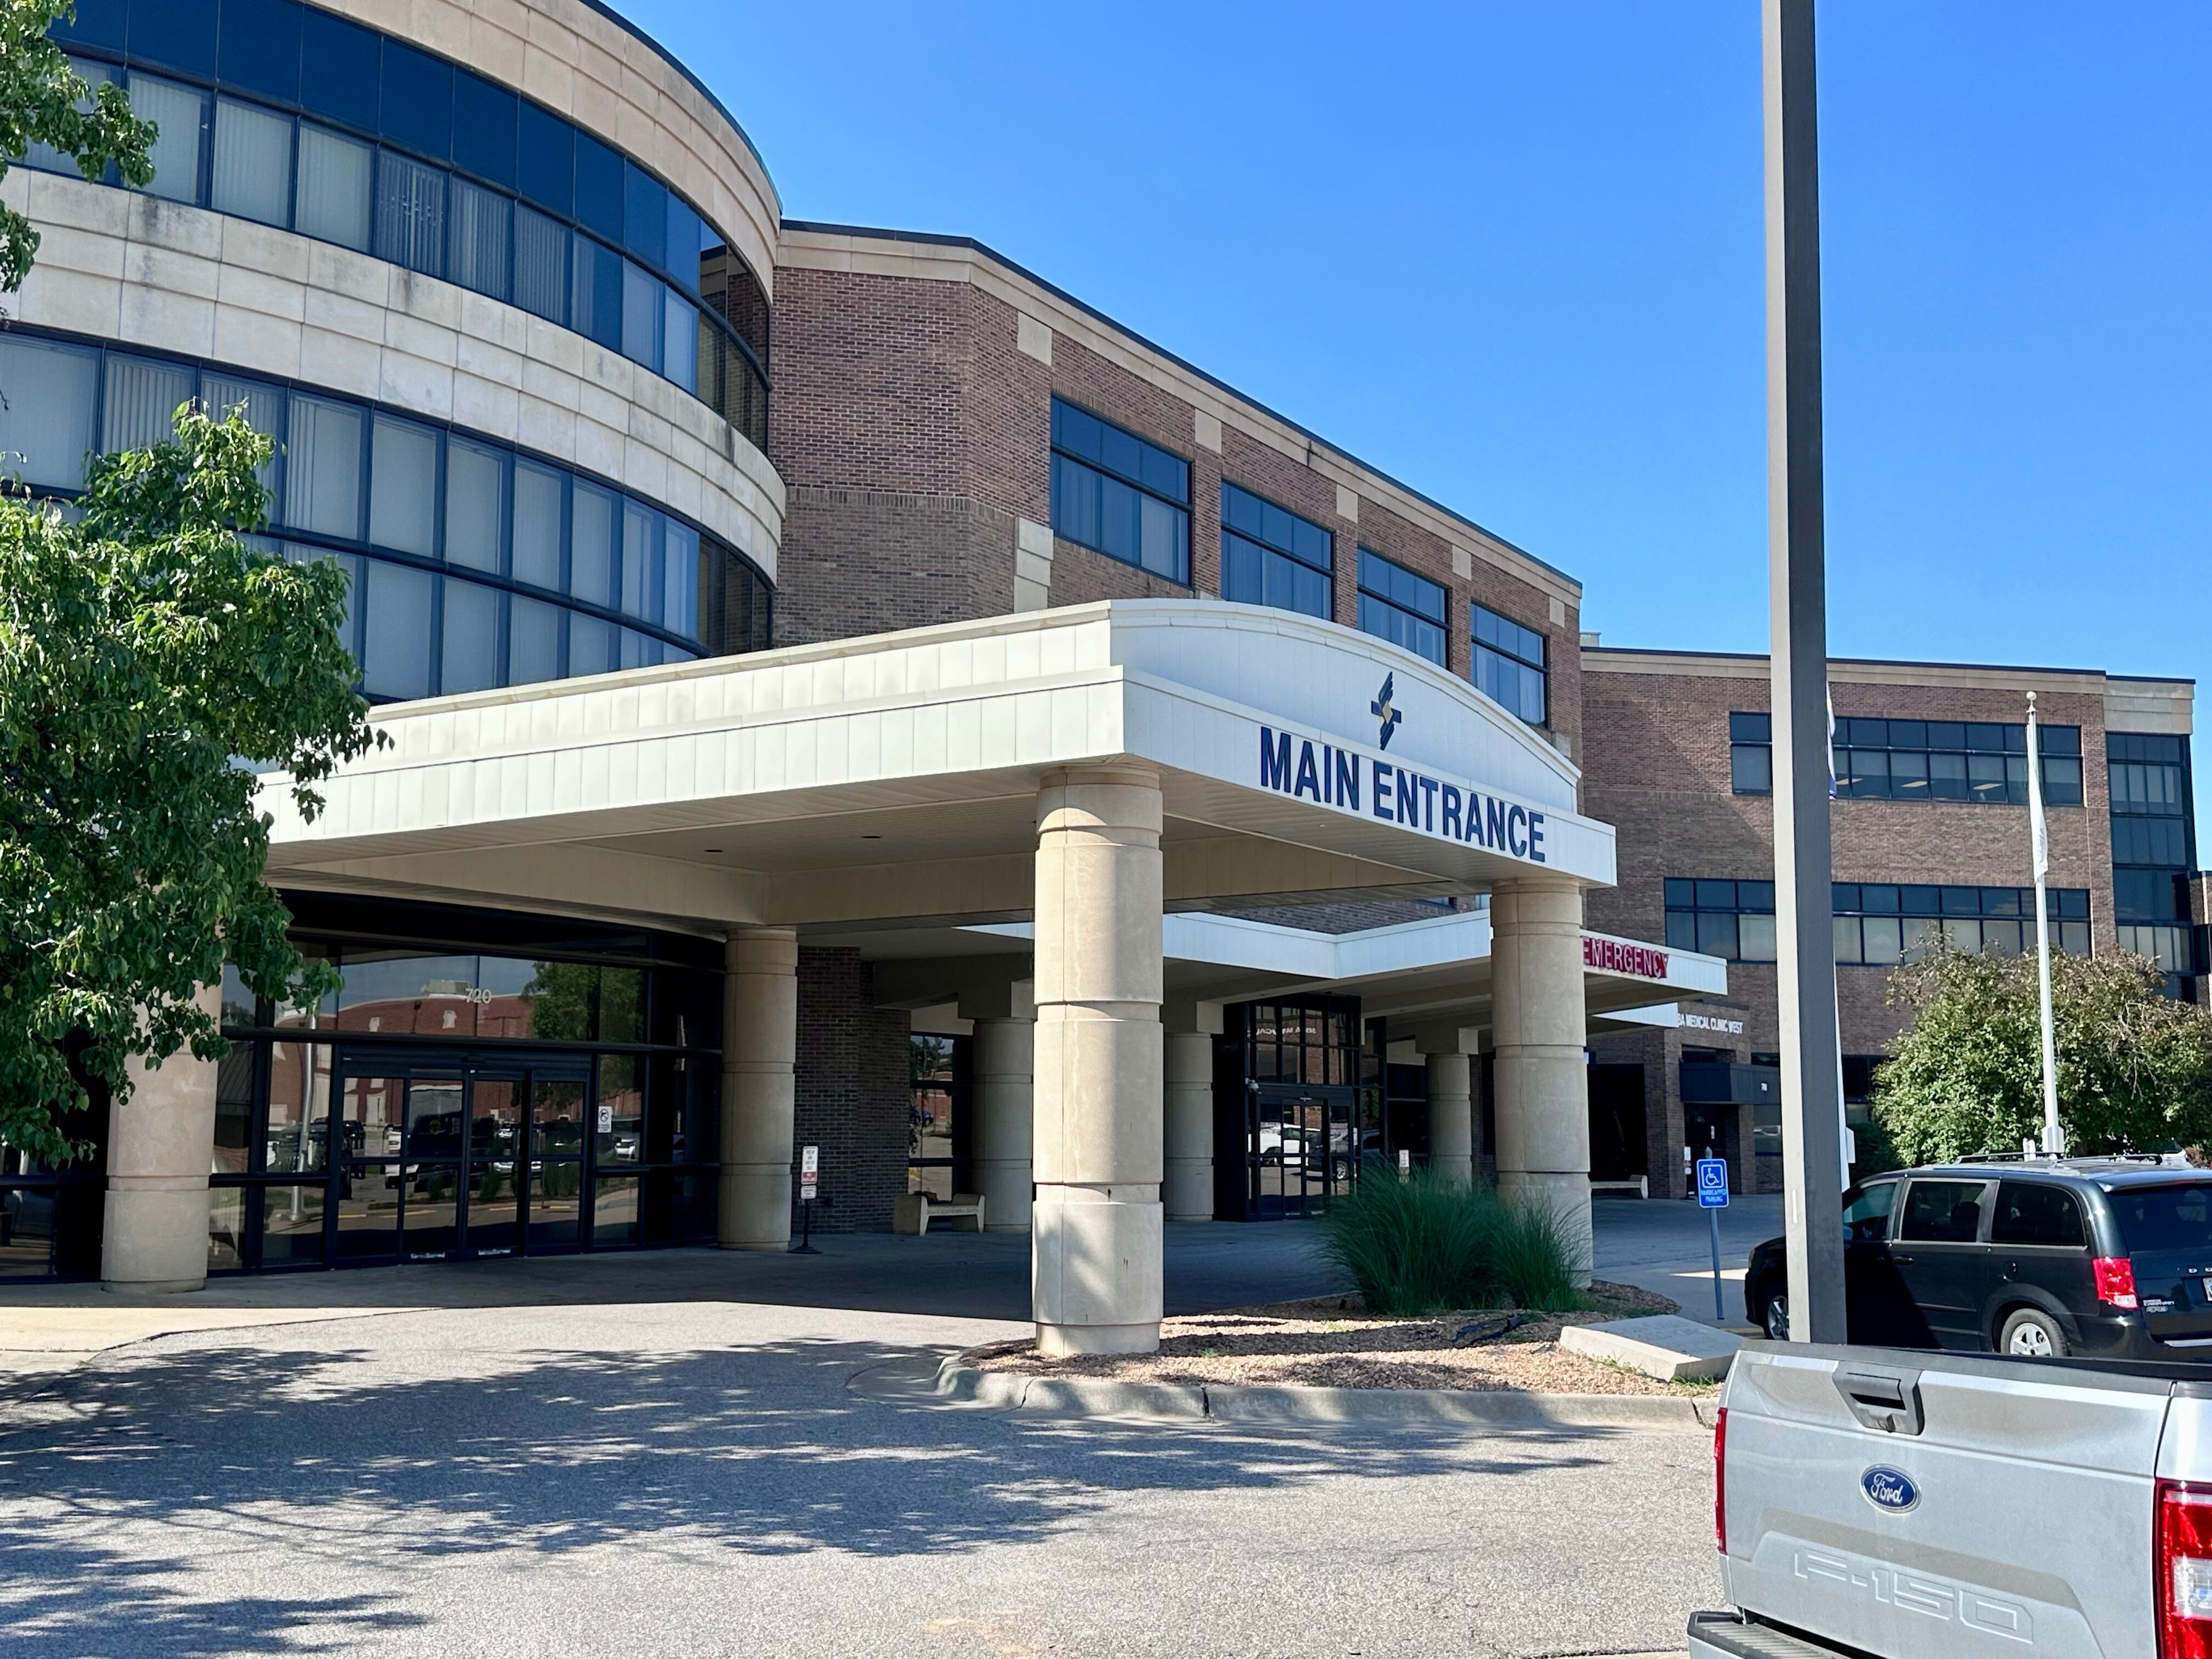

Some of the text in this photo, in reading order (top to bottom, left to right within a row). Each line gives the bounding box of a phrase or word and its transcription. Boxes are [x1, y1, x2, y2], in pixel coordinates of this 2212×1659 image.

[1261, 726, 1545, 862] MAIN ENTRANCE
[1582, 936, 1669, 978] EMERGENCY
[465, 988, 491, 1004] 720
[1871, 1473, 1903, 1504] Ford
[1795, 1547, 2033, 1644] F-150
